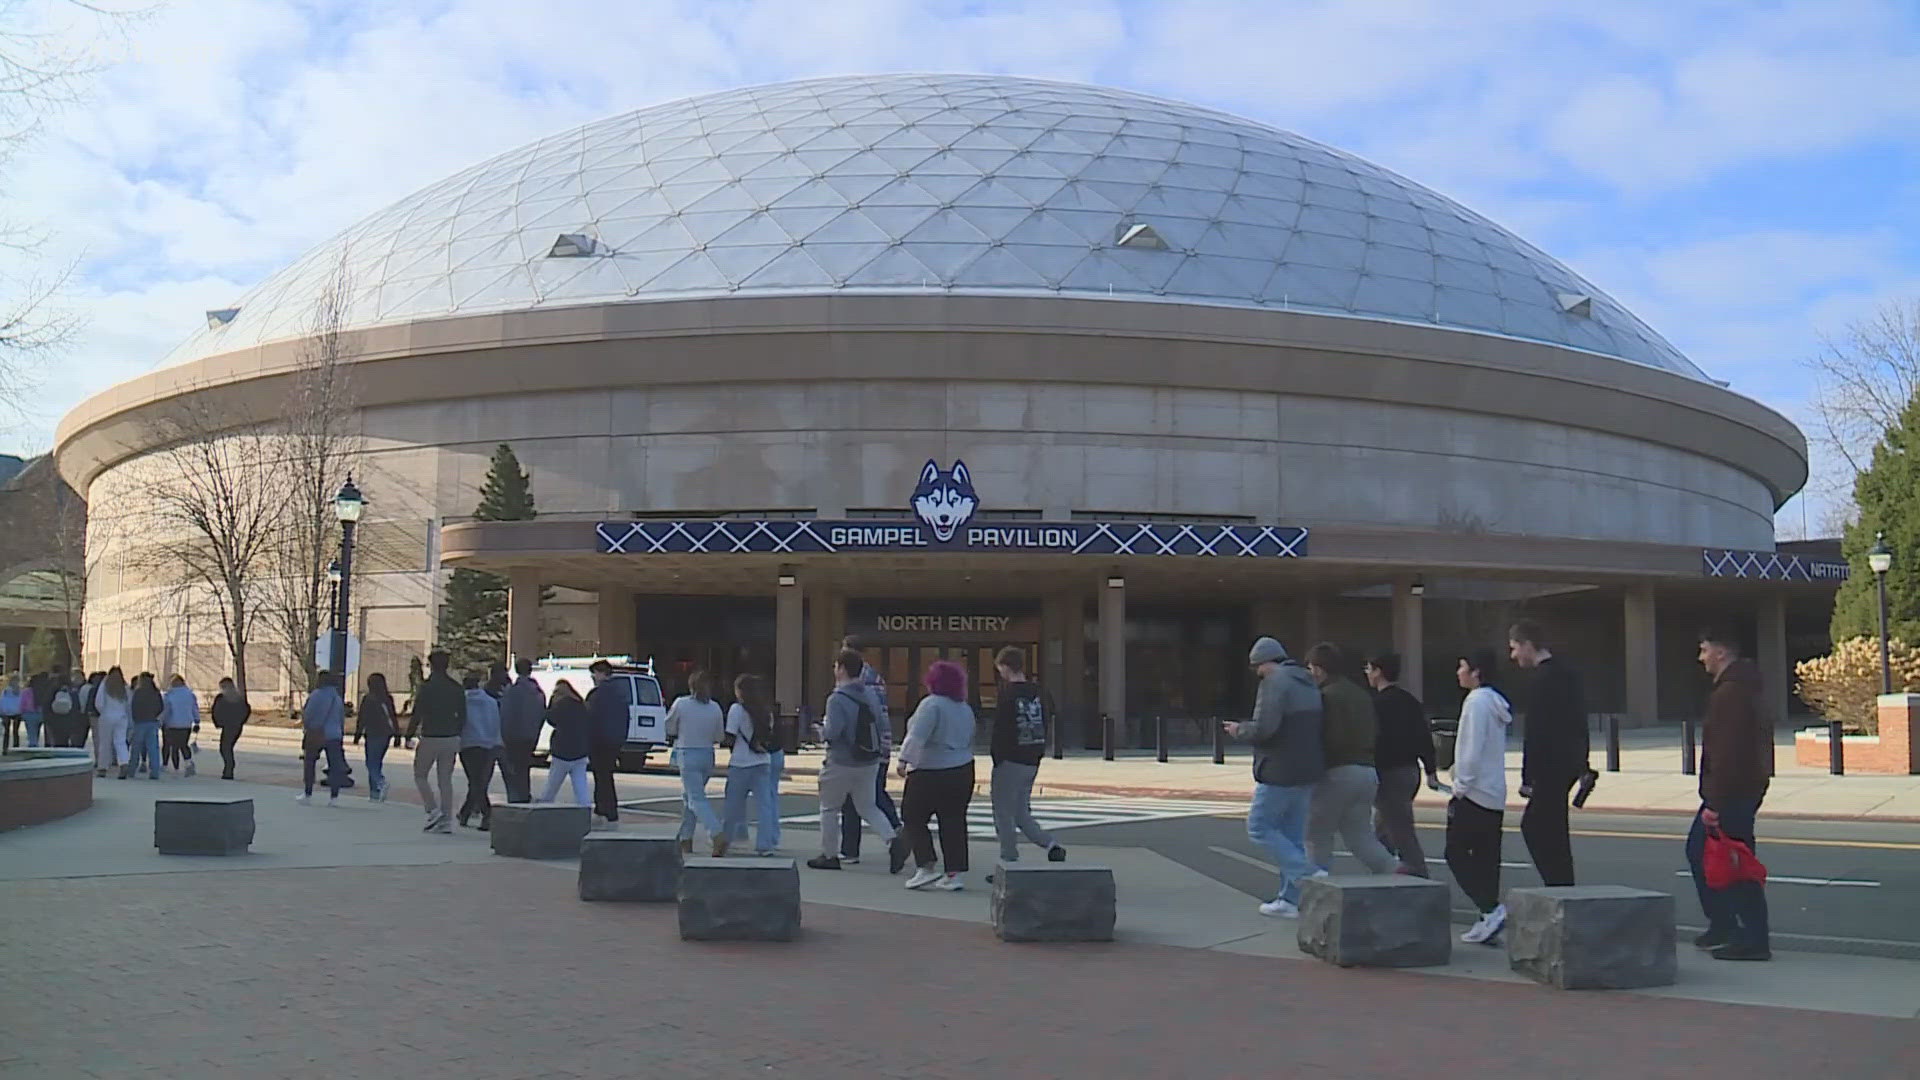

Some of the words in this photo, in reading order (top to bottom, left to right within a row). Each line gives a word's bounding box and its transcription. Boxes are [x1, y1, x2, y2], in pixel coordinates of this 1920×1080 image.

[831, 528, 928, 546] GAMPEL
[968, 529, 1078, 547] PAVILION
[877, 615, 942, 631] NORTH
[948, 616, 1009, 631] ENTRY
